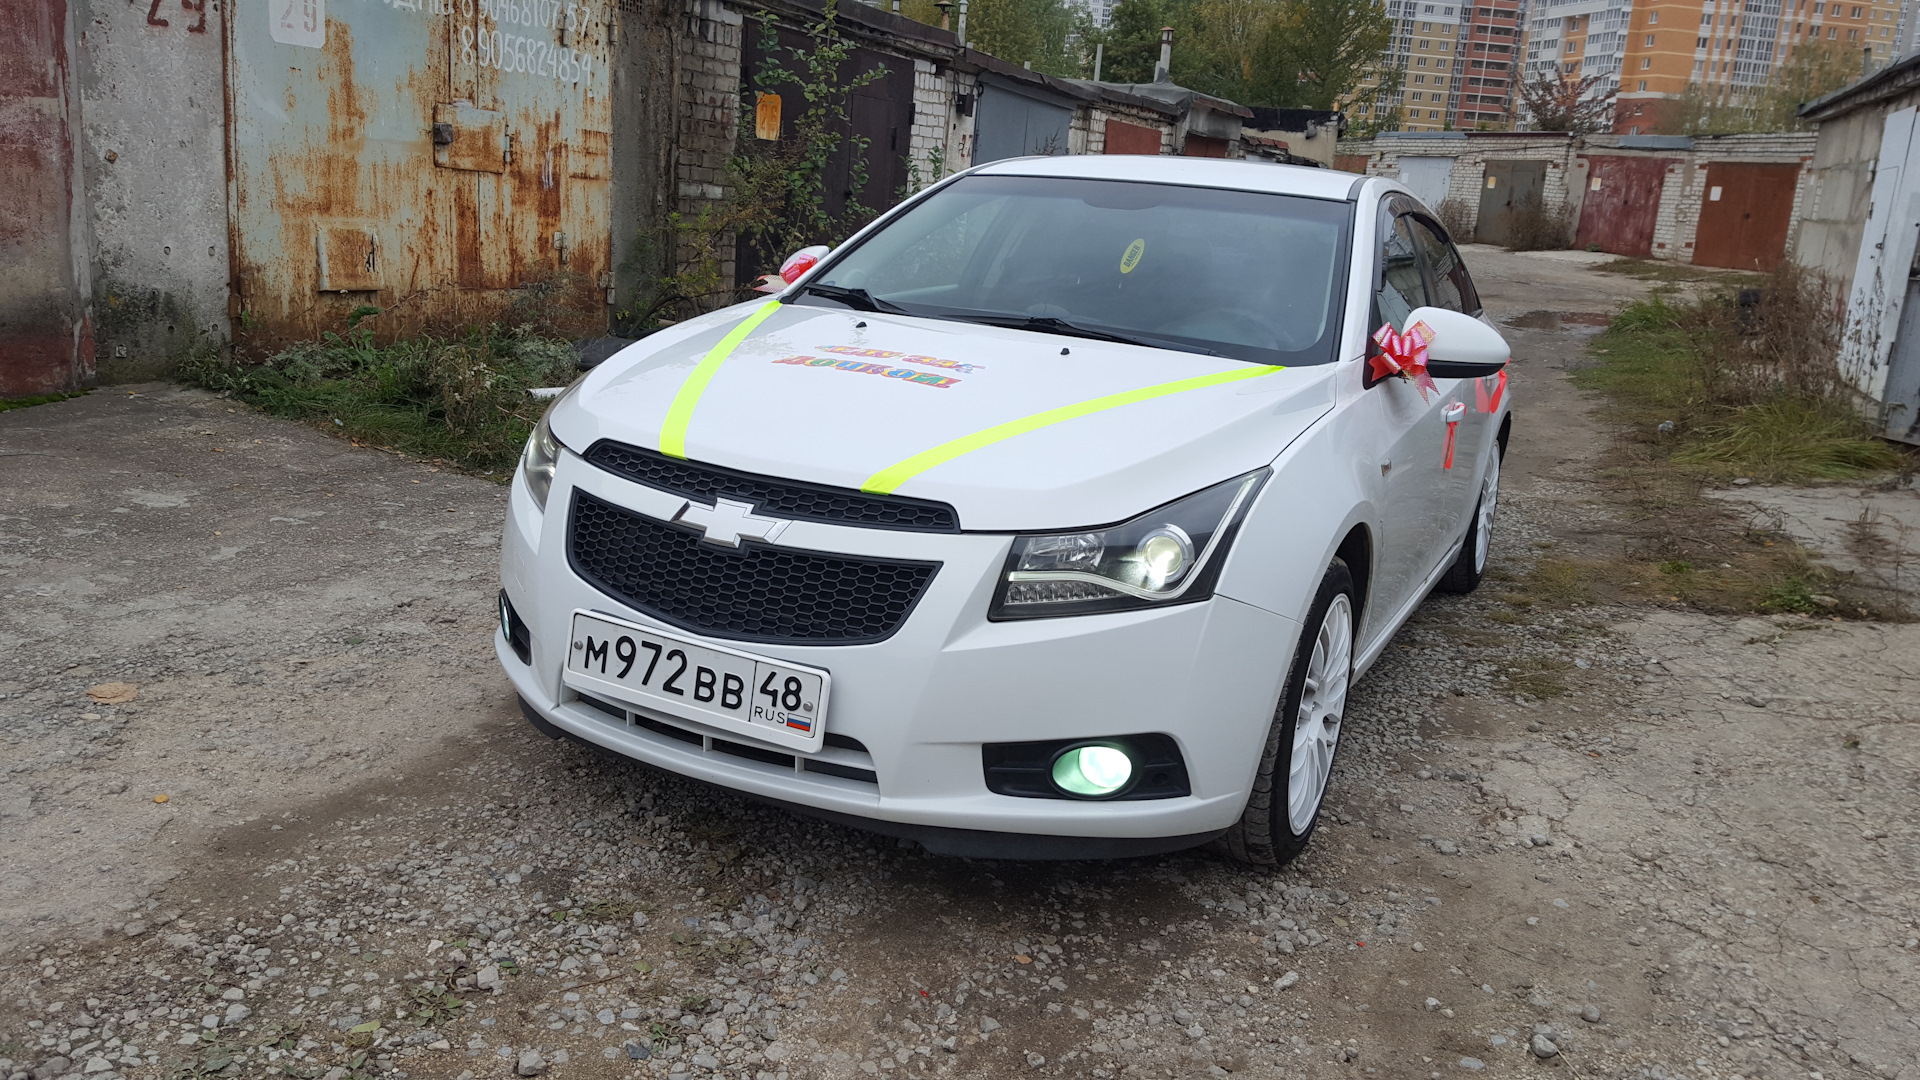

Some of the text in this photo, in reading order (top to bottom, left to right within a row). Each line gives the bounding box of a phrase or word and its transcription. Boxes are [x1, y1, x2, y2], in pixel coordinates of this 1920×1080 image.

[280, 0, 317, 32] 29
[584, 635, 802, 712] M972BB 48
[754, 706, 785, 724] RUS
